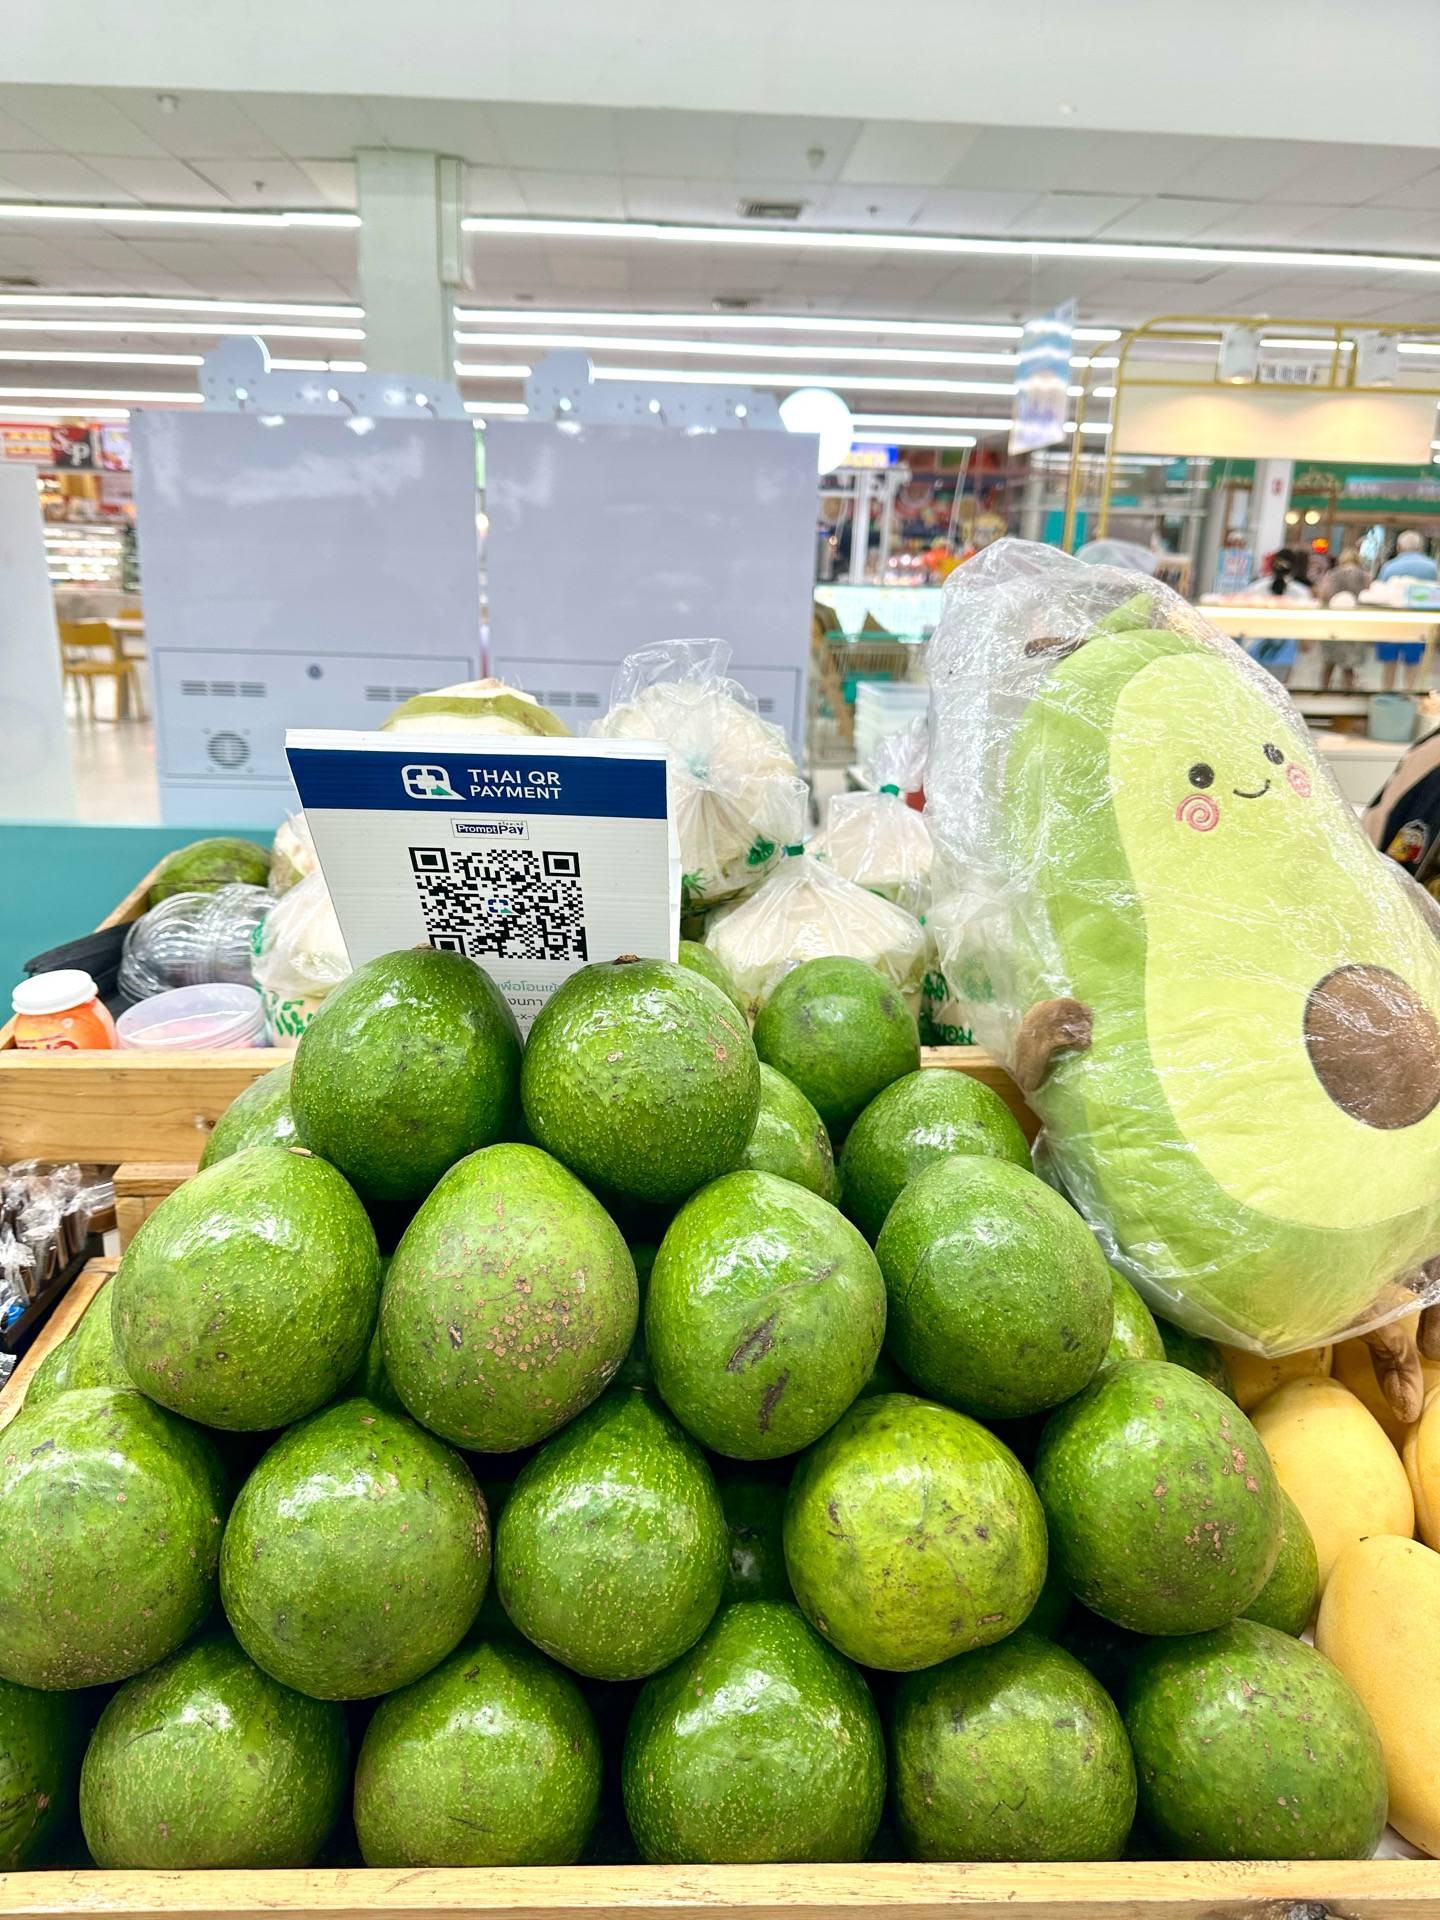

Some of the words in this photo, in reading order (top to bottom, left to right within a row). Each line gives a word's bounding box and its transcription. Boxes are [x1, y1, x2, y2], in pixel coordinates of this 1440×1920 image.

[467, 769, 521, 784] THAI
[528, 770, 561, 785] QR
[470, 785, 562, 800] PAYMENT
